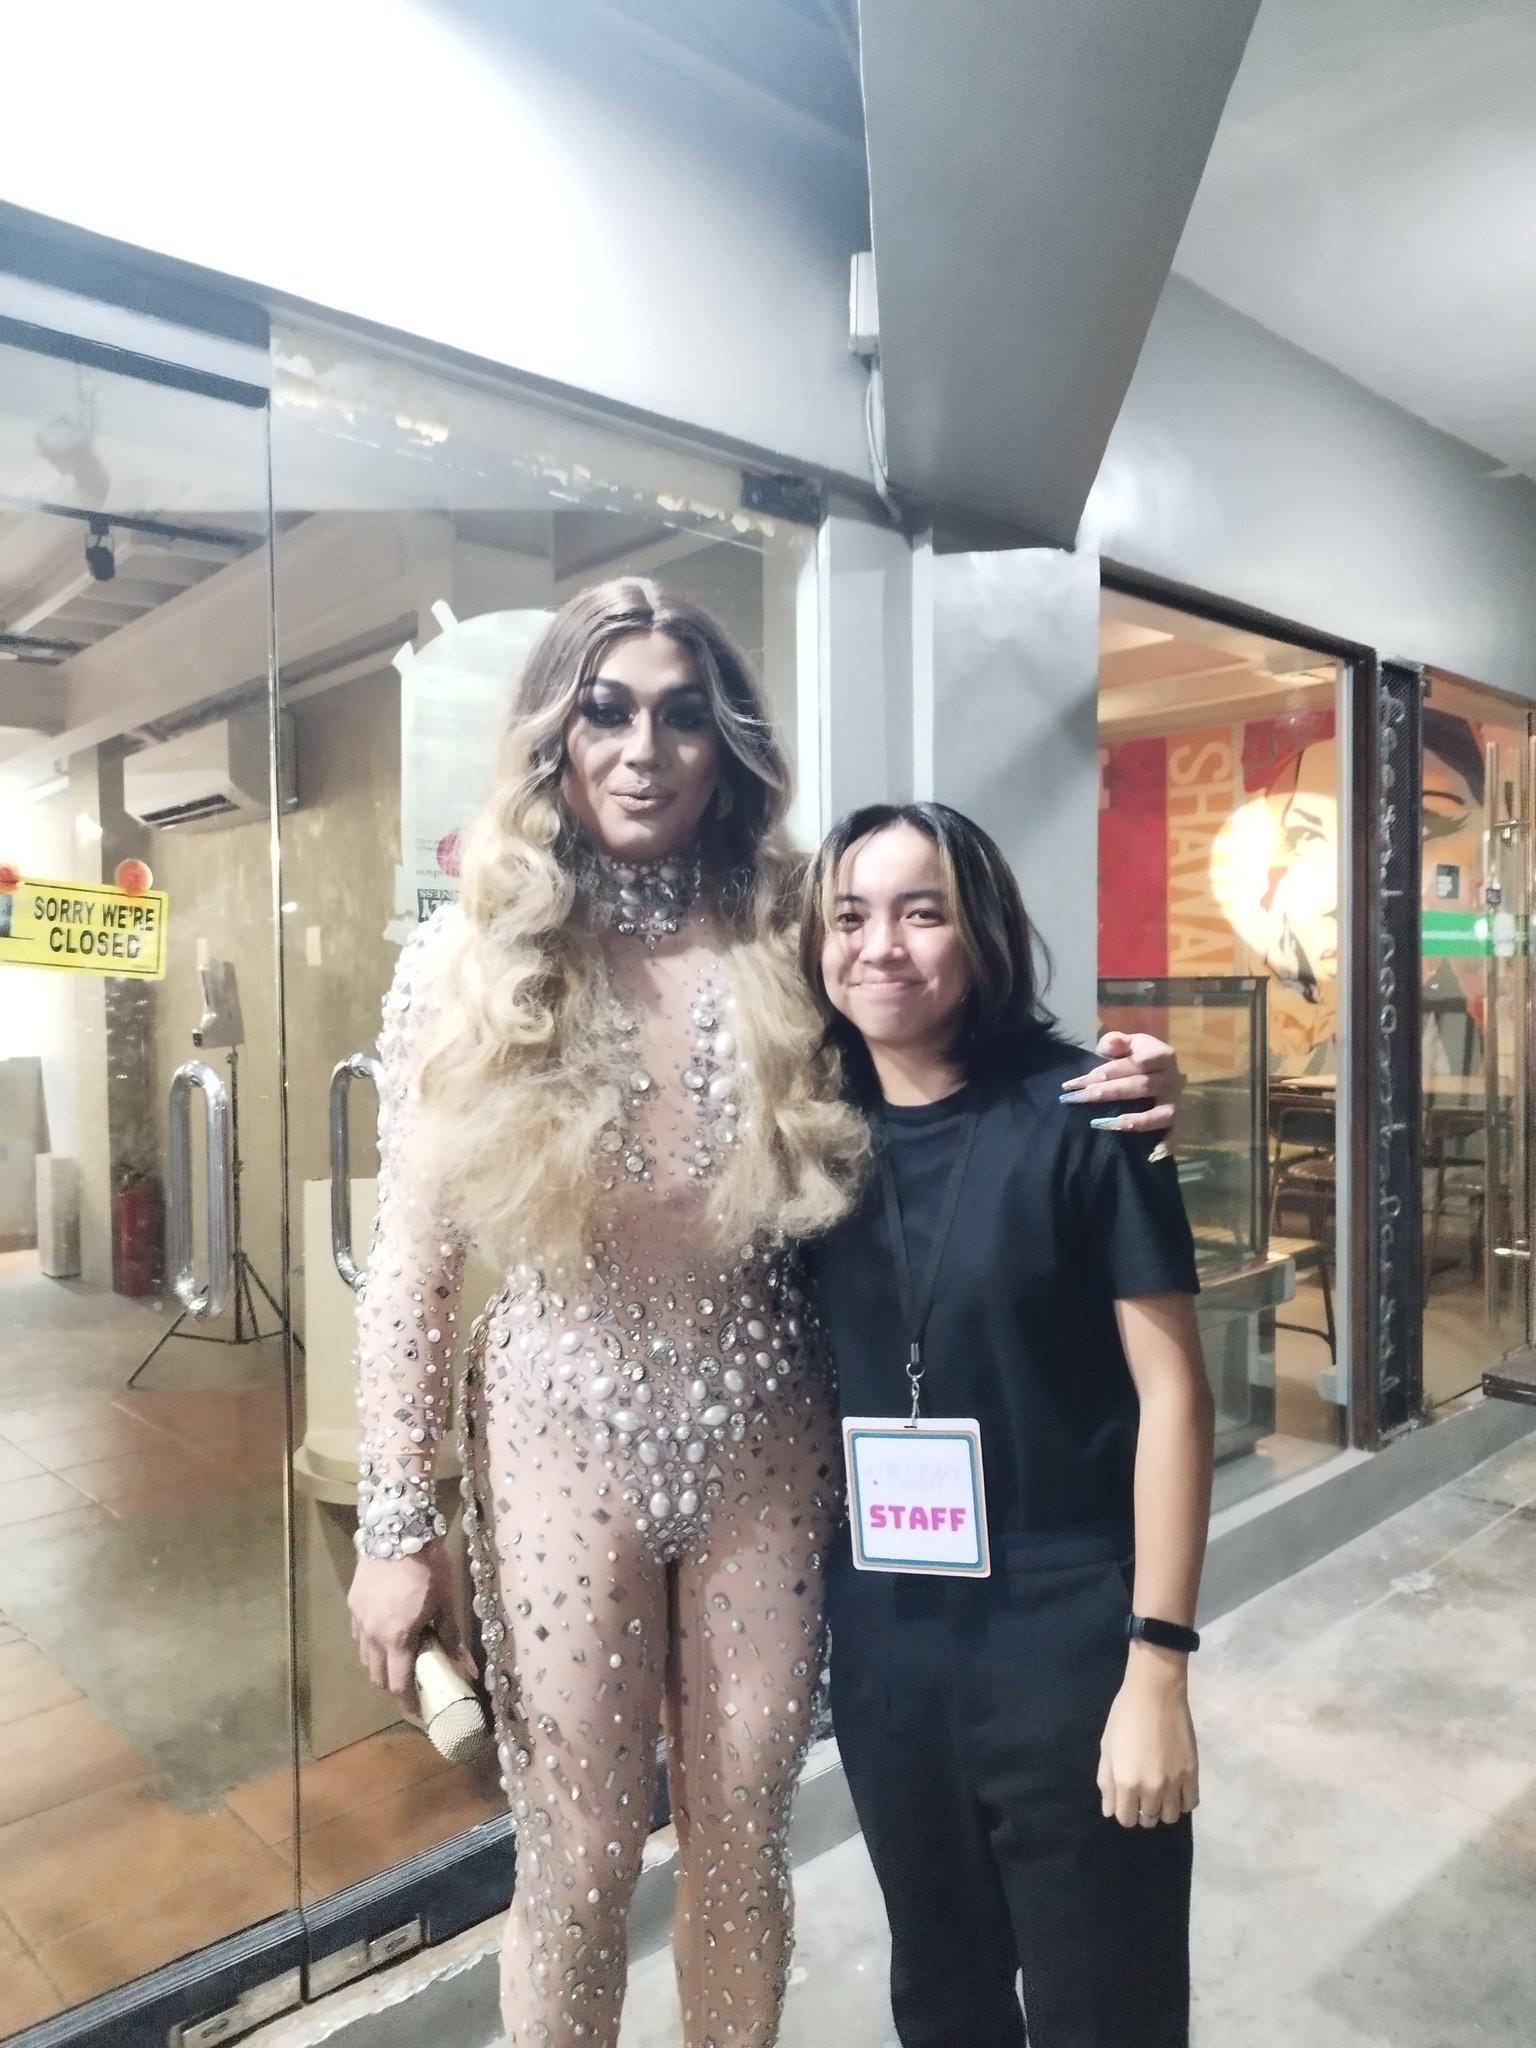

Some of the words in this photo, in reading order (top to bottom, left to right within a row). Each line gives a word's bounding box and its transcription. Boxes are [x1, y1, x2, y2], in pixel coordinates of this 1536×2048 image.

[34, 896, 95, 925] SORRY
[103, 904, 154, 931] WE'RE
[50, 926, 140, 959] CLOSED
[869, 1504, 966, 1532] STAFF
